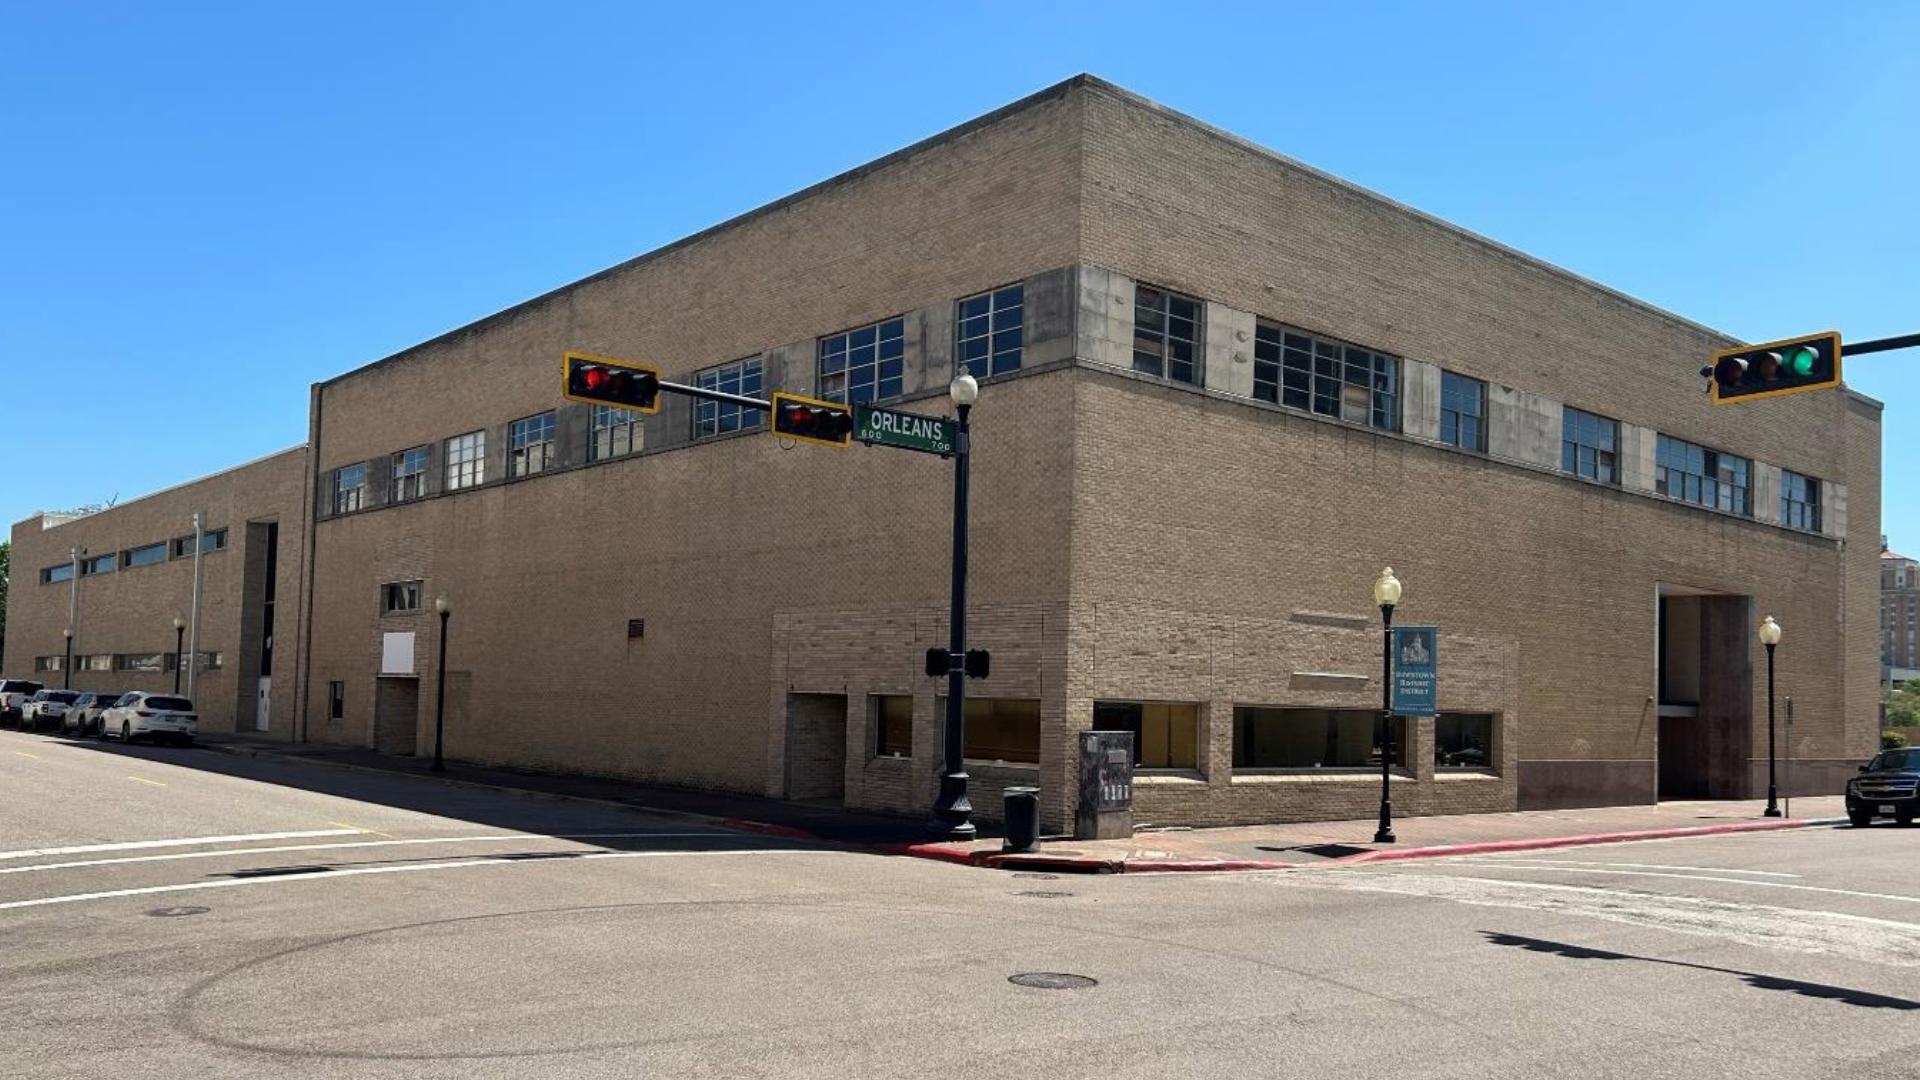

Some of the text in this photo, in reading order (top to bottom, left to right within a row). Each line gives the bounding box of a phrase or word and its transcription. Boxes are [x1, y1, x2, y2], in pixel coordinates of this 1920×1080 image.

[871, 410, 943, 441] ORLEANS
[861, 429, 882, 440] 600
[931, 441, 950, 451] 700
